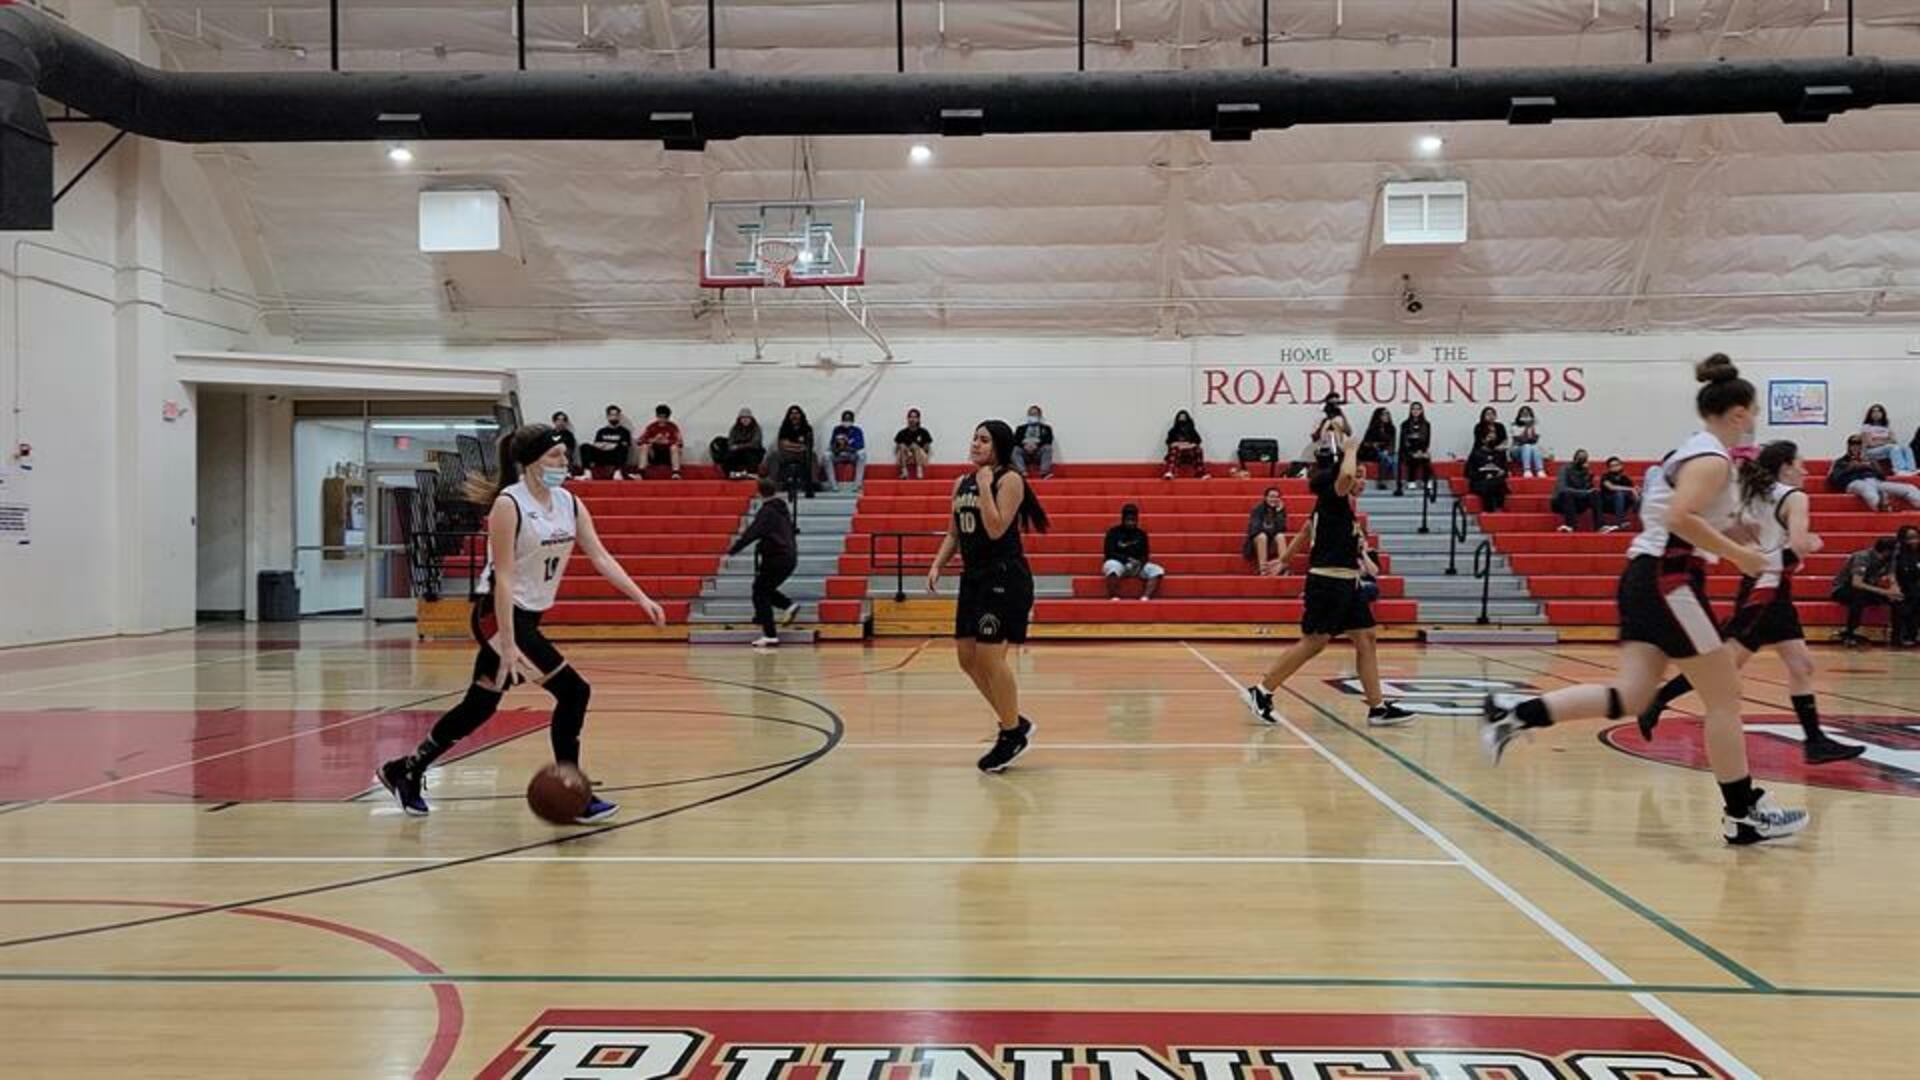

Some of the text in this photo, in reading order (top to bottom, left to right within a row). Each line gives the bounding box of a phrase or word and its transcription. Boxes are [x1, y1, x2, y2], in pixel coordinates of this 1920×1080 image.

[1280, 346, 1469, 363] HOME OF THE
[1202, 367, 1587, 405] ROADRUNNERS
[959, 512, 976, 533] 10
